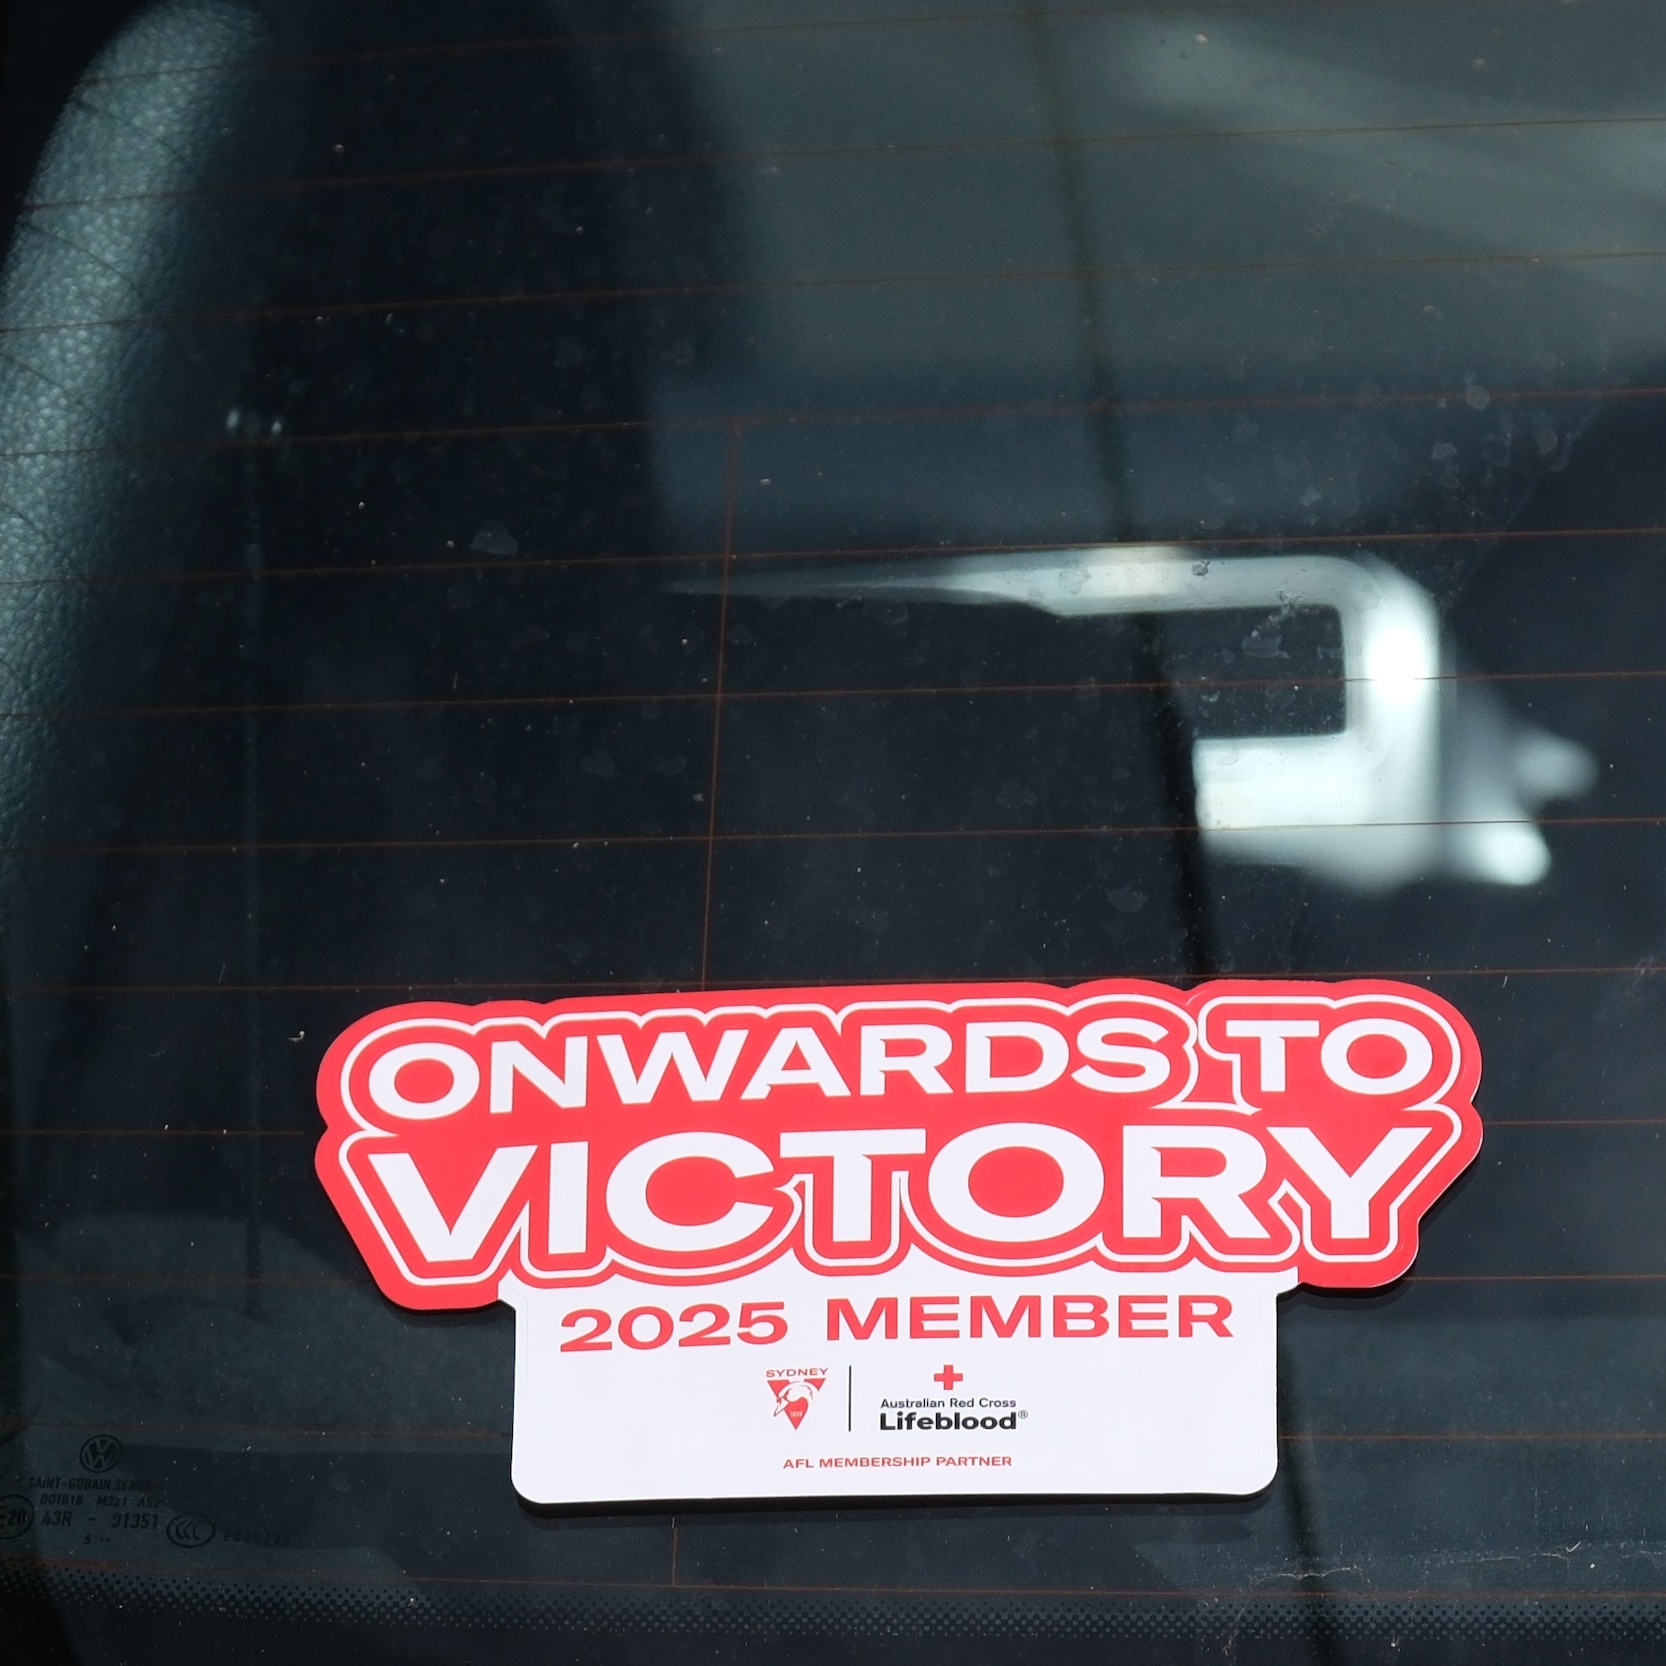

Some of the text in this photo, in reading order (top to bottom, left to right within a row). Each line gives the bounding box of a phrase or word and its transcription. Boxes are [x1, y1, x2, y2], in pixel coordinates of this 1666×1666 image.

[369, 1018, 1433, 1119] ONWARDS TO
[368, 1123, 1433, 1262] VICTORY
[560, 1294, 1234, 1353] 2025 MEMBER
[765, 1367, 829, 1378] SYDNEY
[880, 1397, 1017, 1409] Australian Red Cross
[782, 1456, 1012, 1469] AFL MEMBERSHIP PARTNER
[28, 1476, 112, 1491] SAINT-GOBAIN
[42, 1510, 73, 1528] 43R
